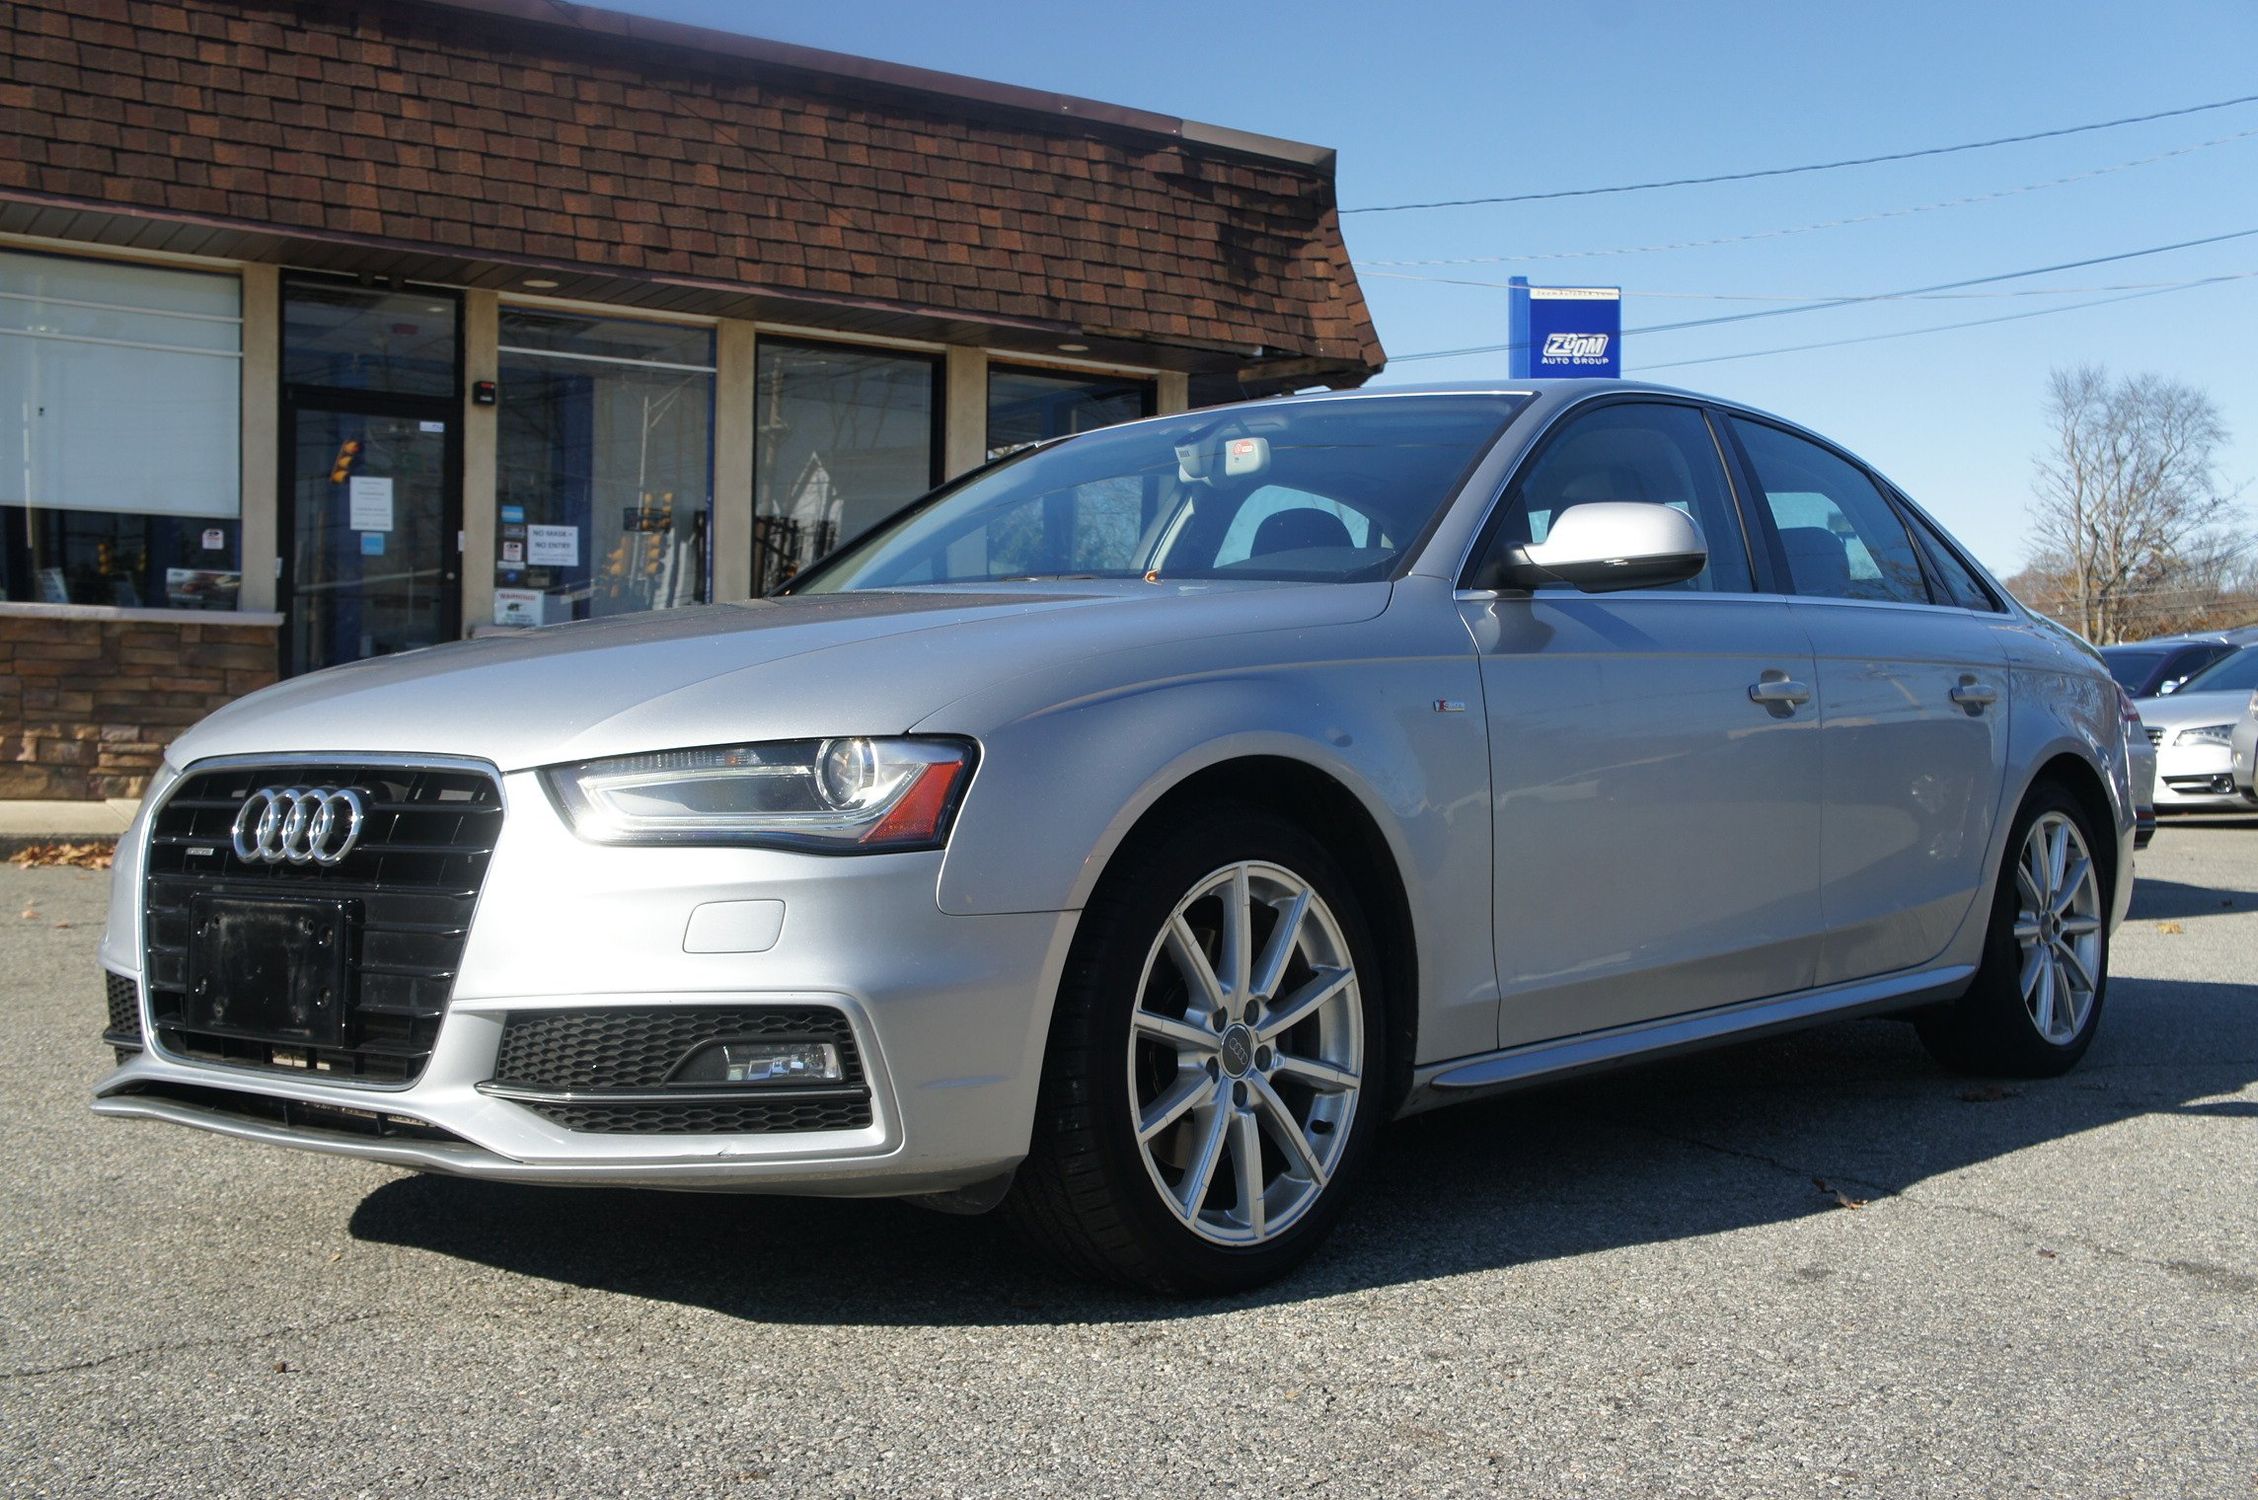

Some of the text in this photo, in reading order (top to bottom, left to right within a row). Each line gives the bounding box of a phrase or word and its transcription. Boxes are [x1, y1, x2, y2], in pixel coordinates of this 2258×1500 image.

[1547, 334, 1605, 356] ZOOM
[1542, 357, 1609, 365] AUTO GROUP
[533, 529, 544, 537] NO
